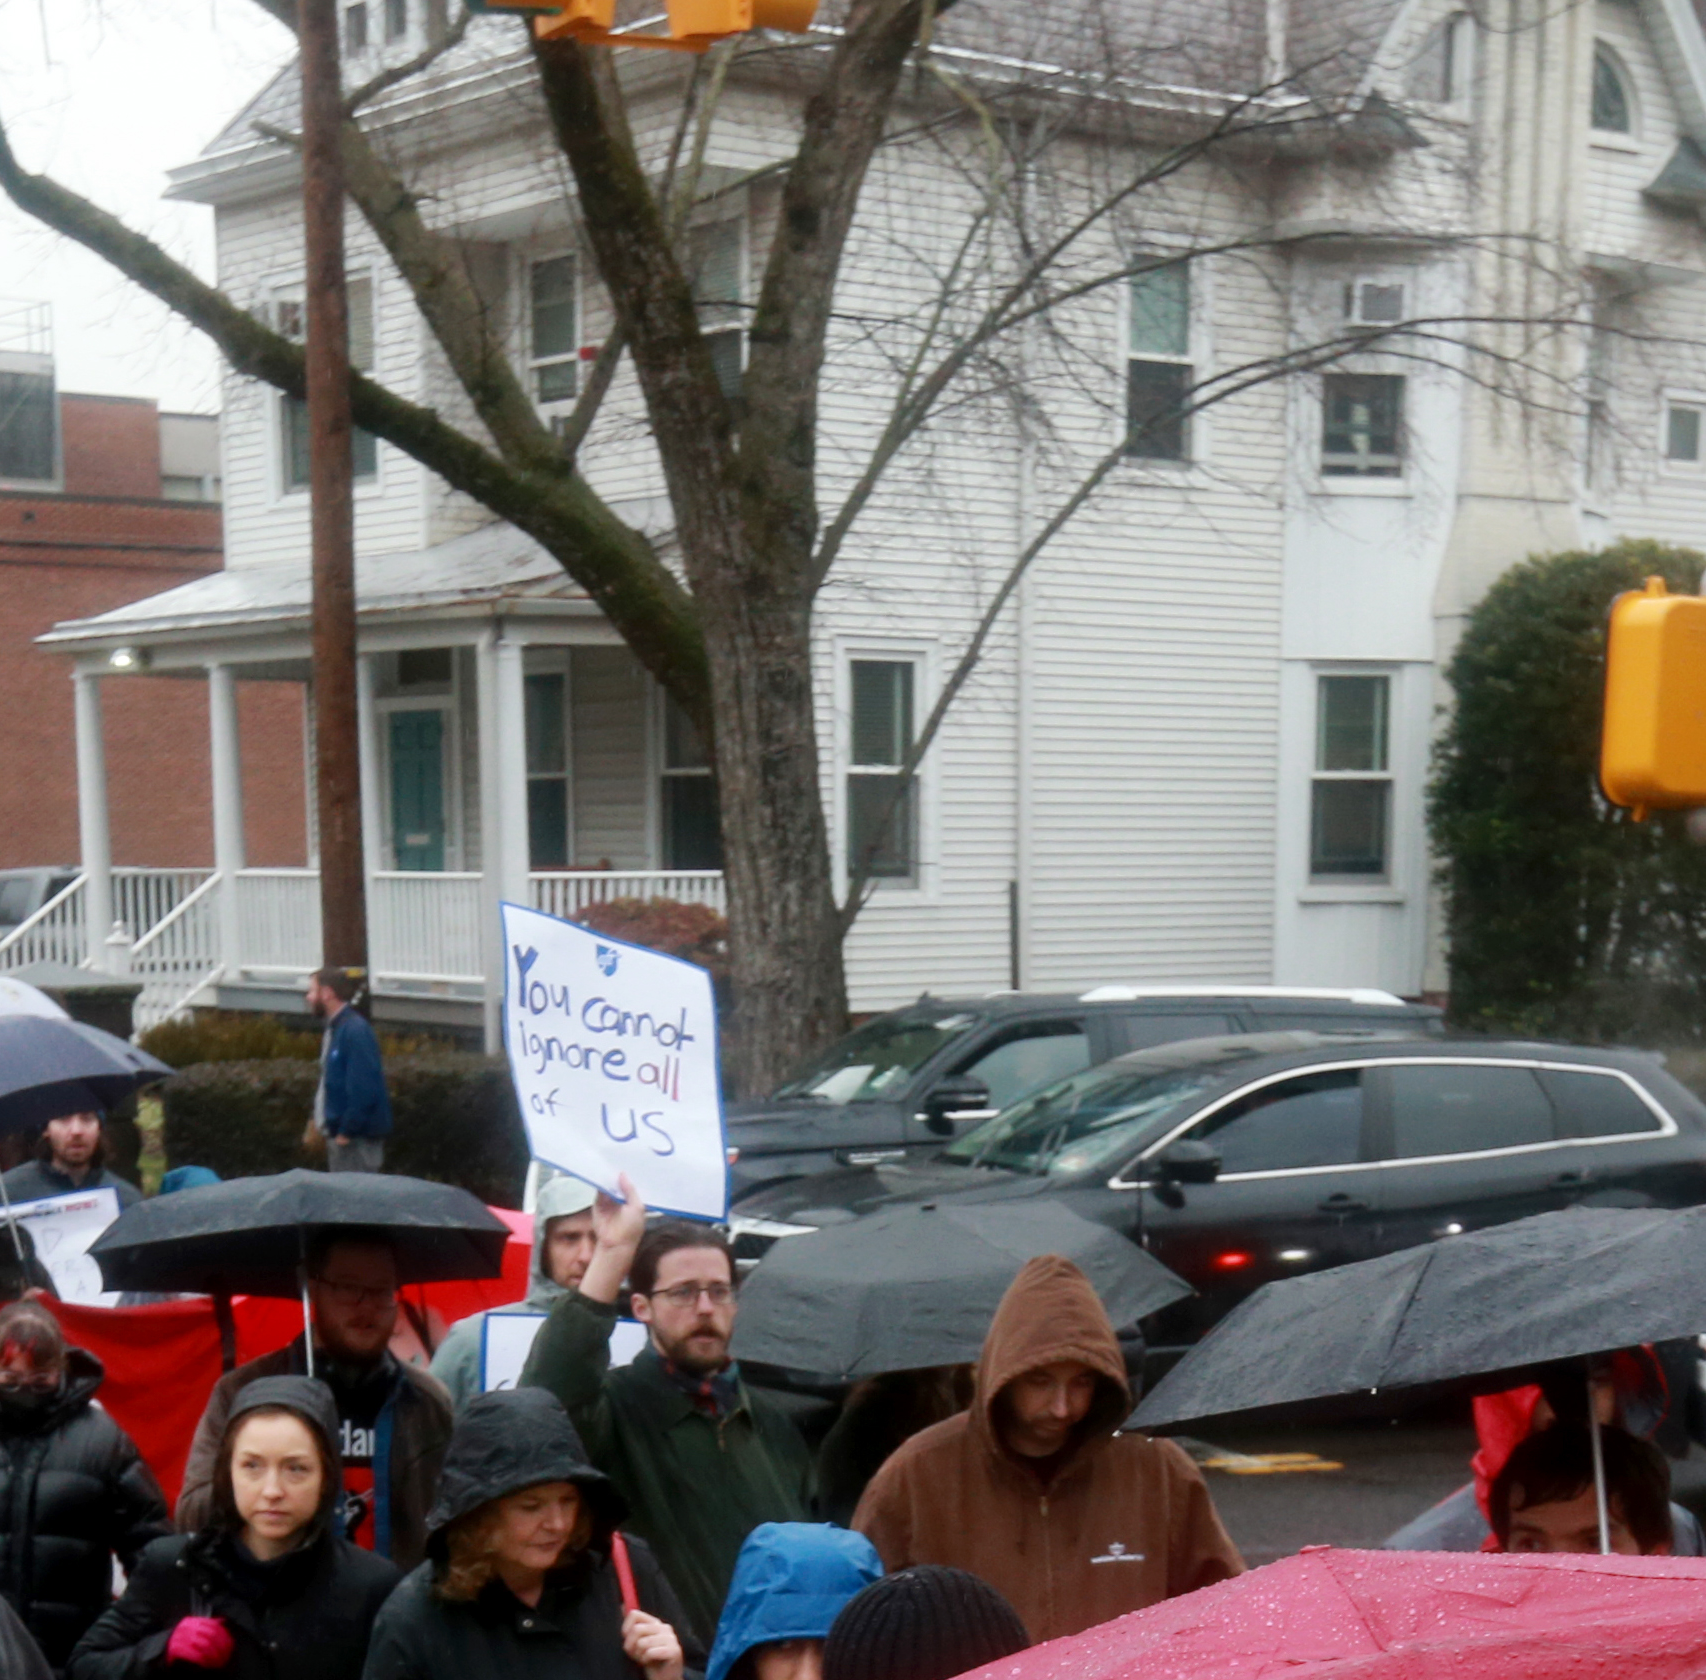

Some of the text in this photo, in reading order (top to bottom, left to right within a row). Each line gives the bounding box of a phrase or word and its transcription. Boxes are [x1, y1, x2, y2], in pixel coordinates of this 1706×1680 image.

[512, 943, 572, 1017] You
[581, 996, 695, 1051] cannot
[518, 1019, 680, 1102] ignore all
[530, 1087, 563, 1117] of
